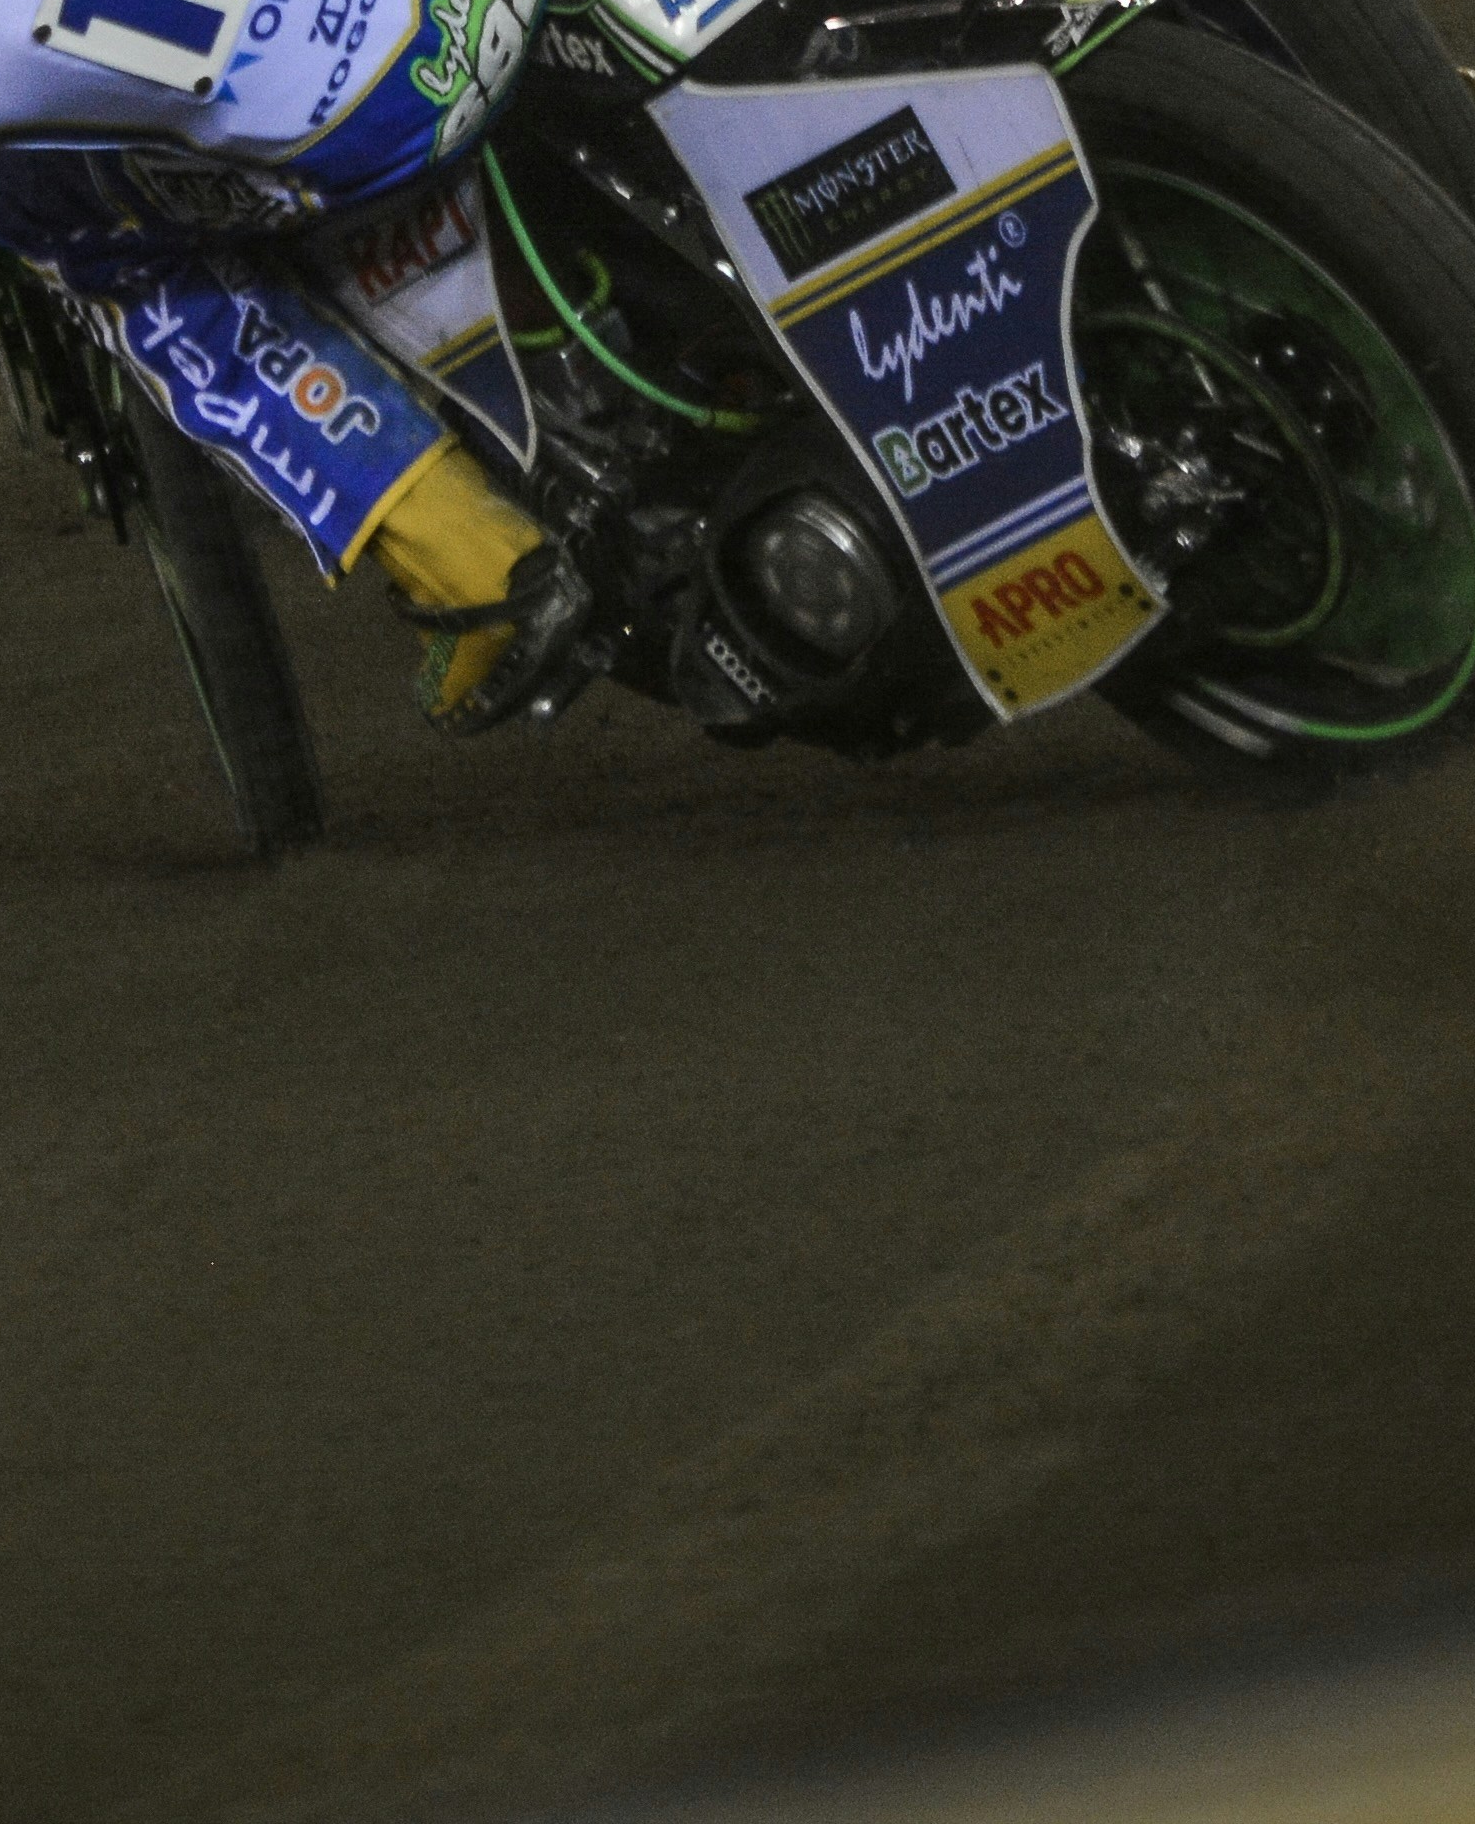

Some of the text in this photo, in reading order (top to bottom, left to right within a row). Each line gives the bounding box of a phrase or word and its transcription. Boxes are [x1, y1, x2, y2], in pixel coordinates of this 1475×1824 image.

[793, 128, 930, 216] MONSTER
[233, 296, 381, 445] JOPA
[872, 360, 1069, 499] Bartex
[971, 550, 1105, 649] APRO
